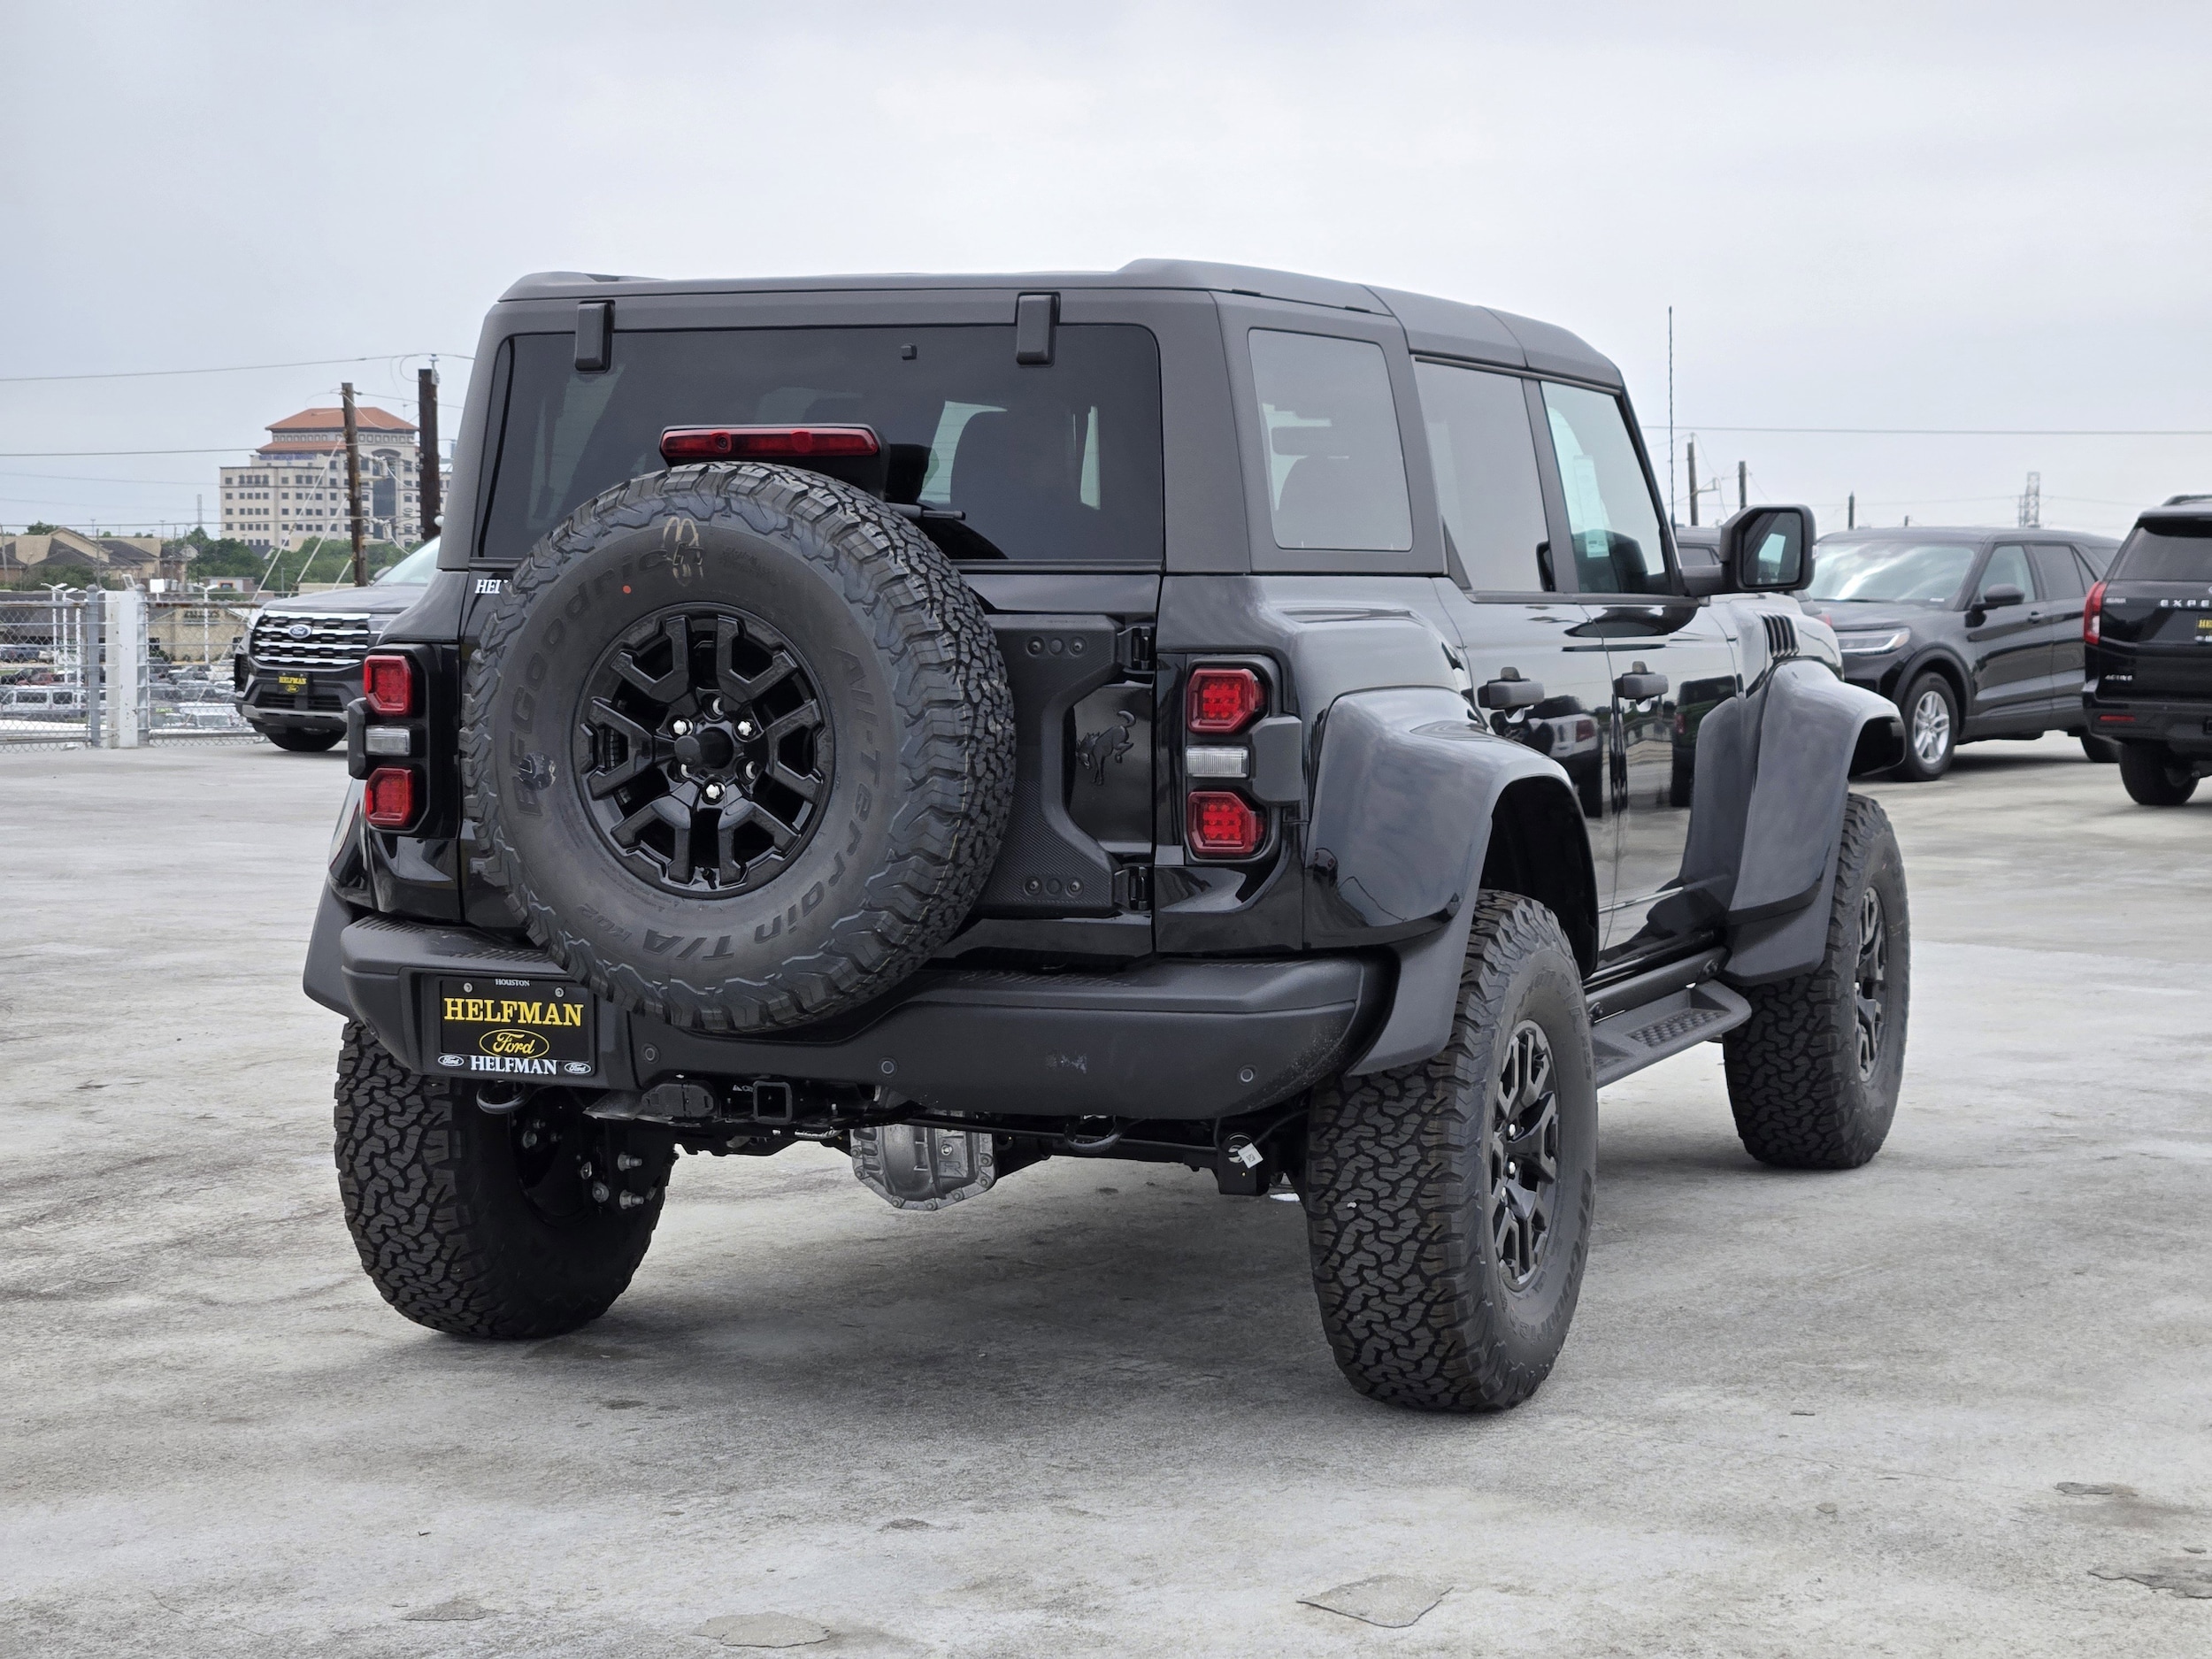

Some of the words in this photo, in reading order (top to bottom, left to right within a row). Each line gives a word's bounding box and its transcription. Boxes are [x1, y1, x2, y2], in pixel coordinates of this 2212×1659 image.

[475, 579, 509, 594] HEL
[641, 928, 736, 961] T/A
[444, 997, 584, 1026] HELFMAN
[492, 1032, 536, 1056] Ford
[470, 1055, 557, 1075] HELFMAN
